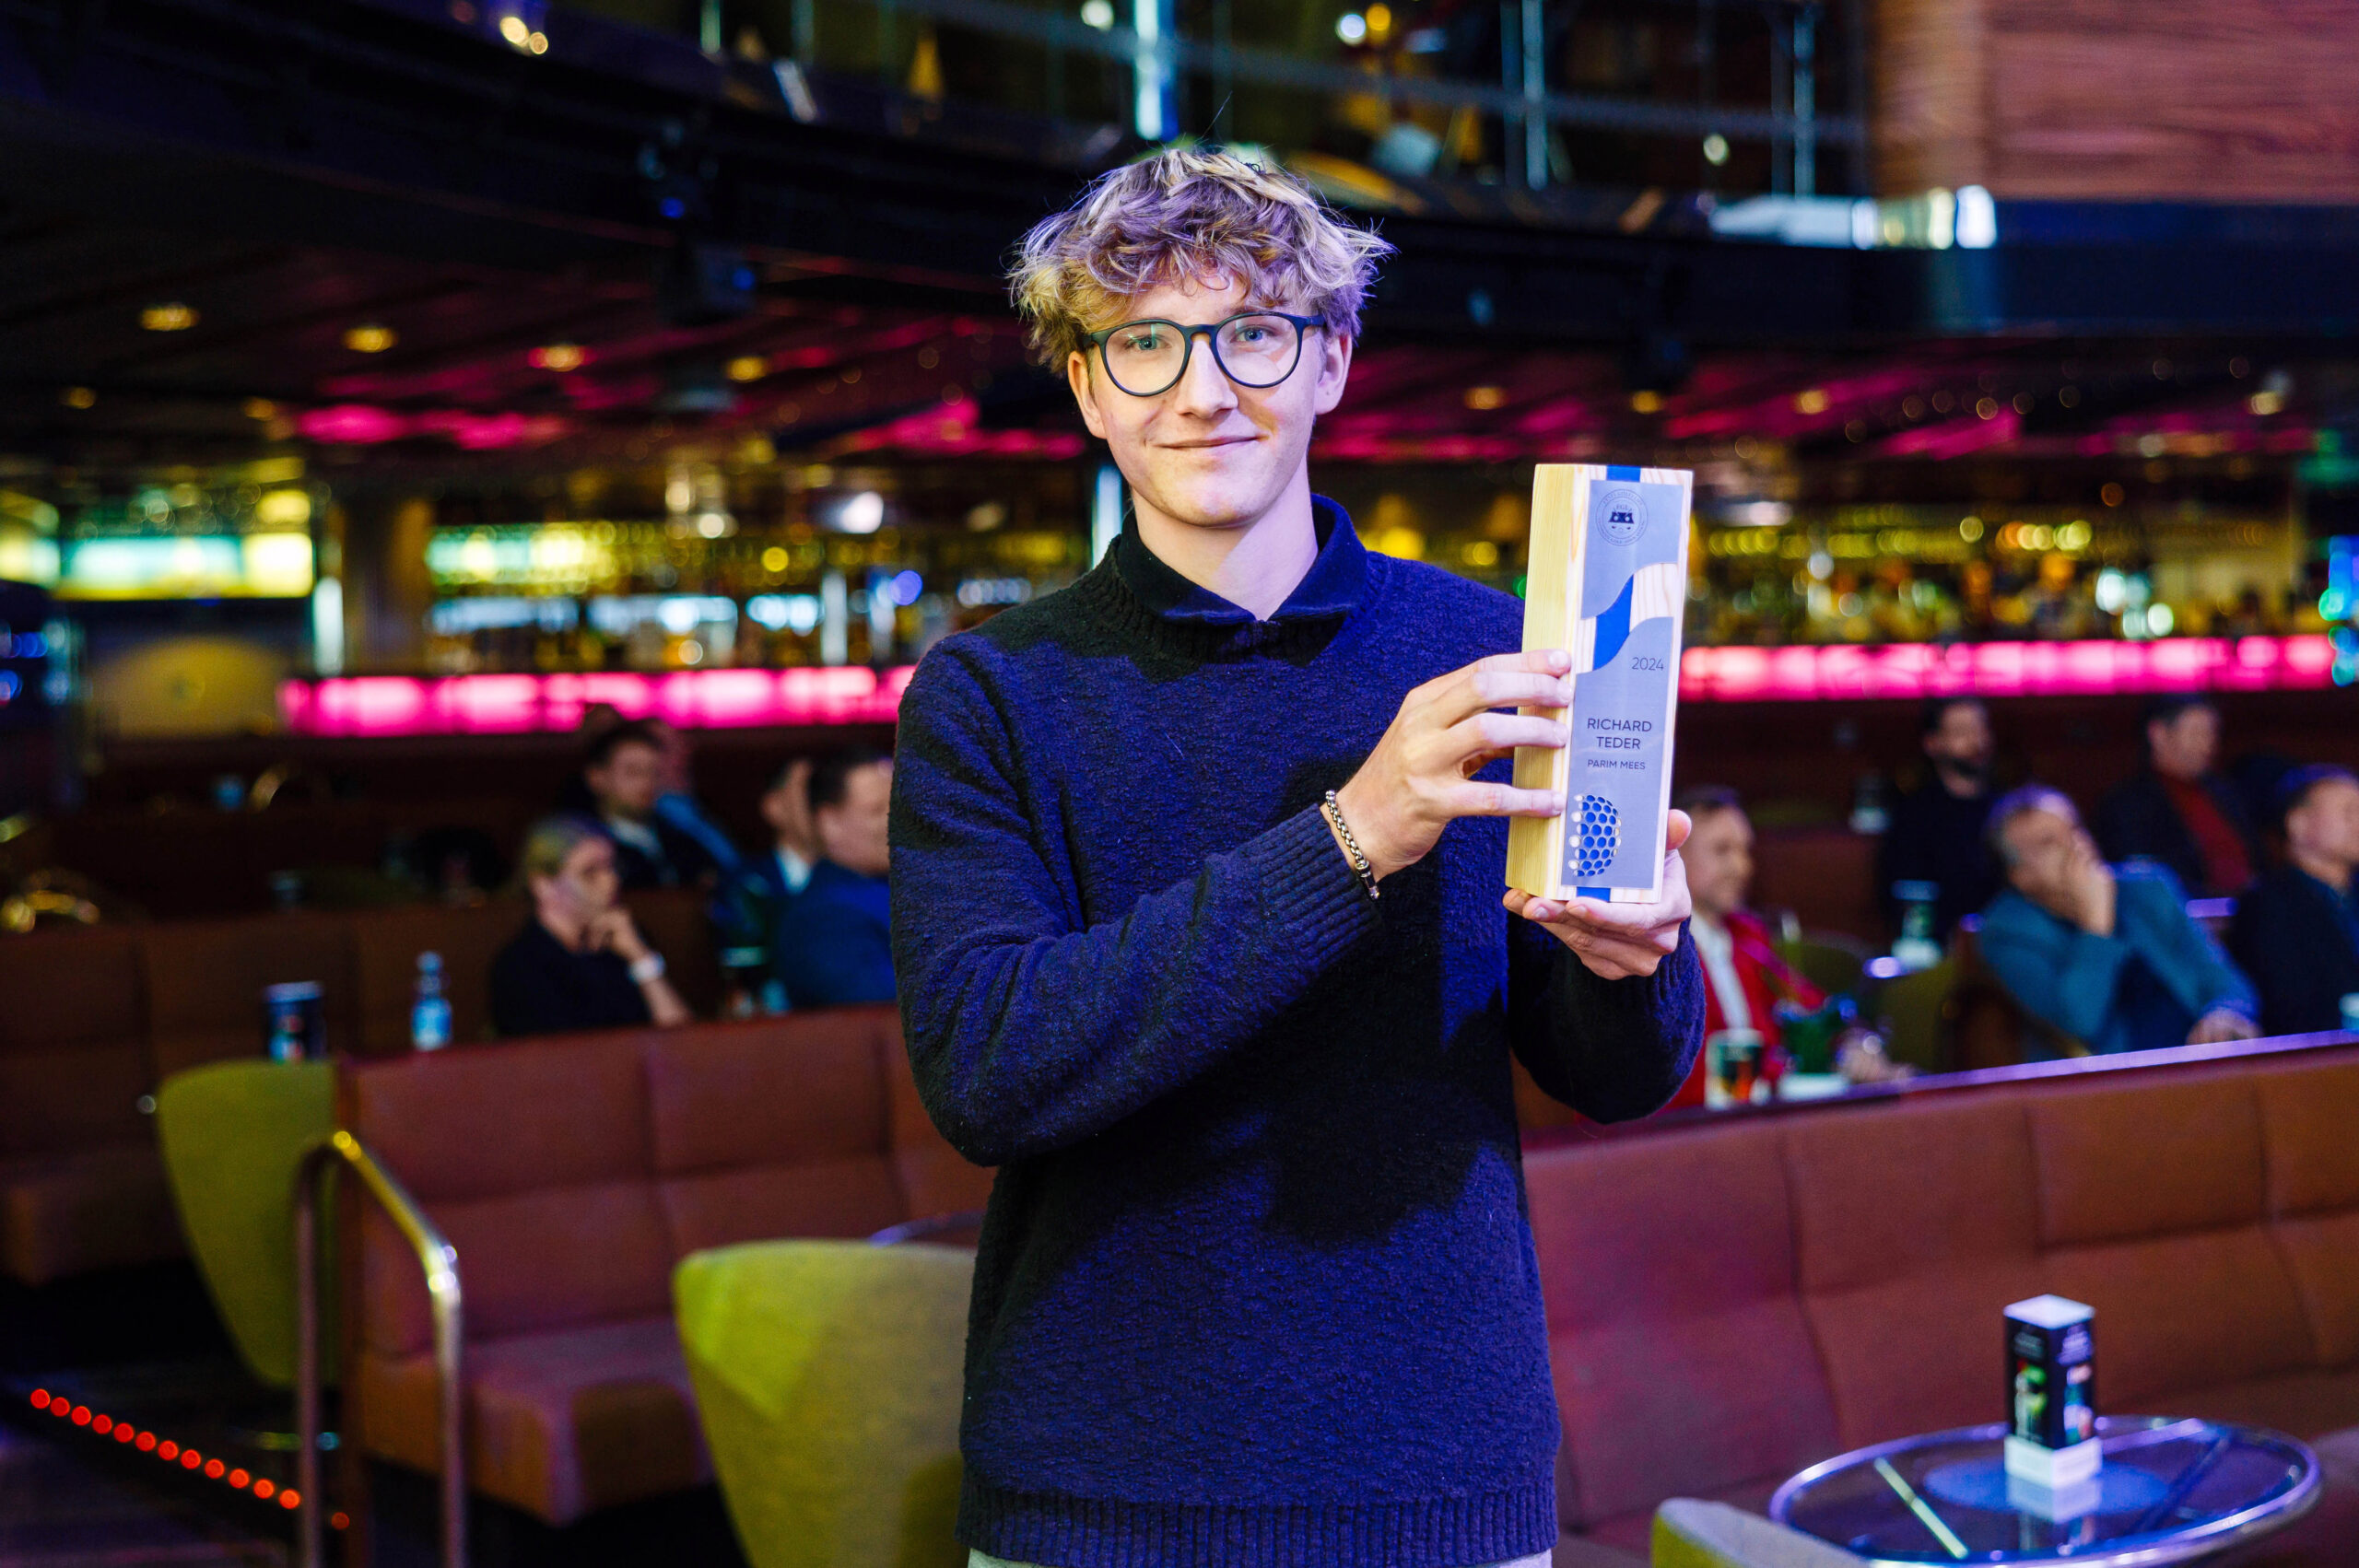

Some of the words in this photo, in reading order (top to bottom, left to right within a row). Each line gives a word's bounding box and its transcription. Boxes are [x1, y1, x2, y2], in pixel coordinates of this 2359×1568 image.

[1631, 657, 1664, 671] 2024
[1587, 718, 1652, 732] RICHARD
[1596, 736, 1641, 749] TEDER
[1587, 758, 1617, 769] PARIM
[1620, 760, 1646, 770] MEES
